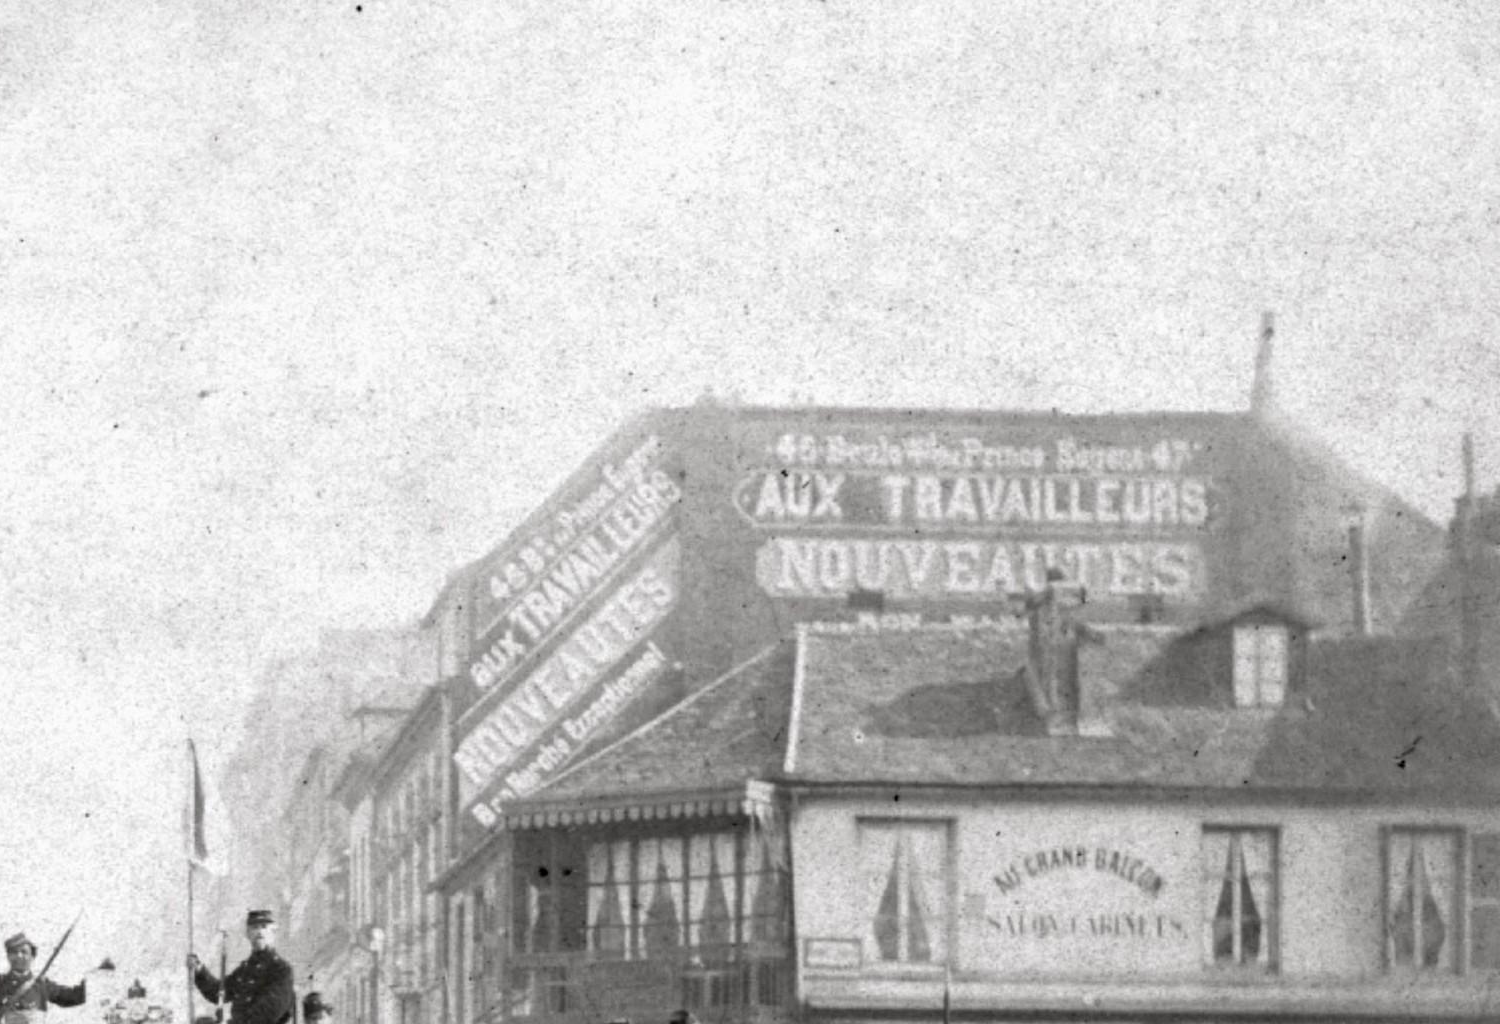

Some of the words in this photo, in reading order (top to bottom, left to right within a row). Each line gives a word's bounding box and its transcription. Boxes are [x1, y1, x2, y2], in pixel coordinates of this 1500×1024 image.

[755, 472, 843, 517] AUX
[882, 475, 1209, 524] TRAVAILLEURS
[508, 470, 682, 639] TRAVAILLEURS
[453, 566, 673, 785] NOUVEAUTES
[1023, 847, 1088, 878] GRAND
[1094, 847, 1164, 899] BALCON
